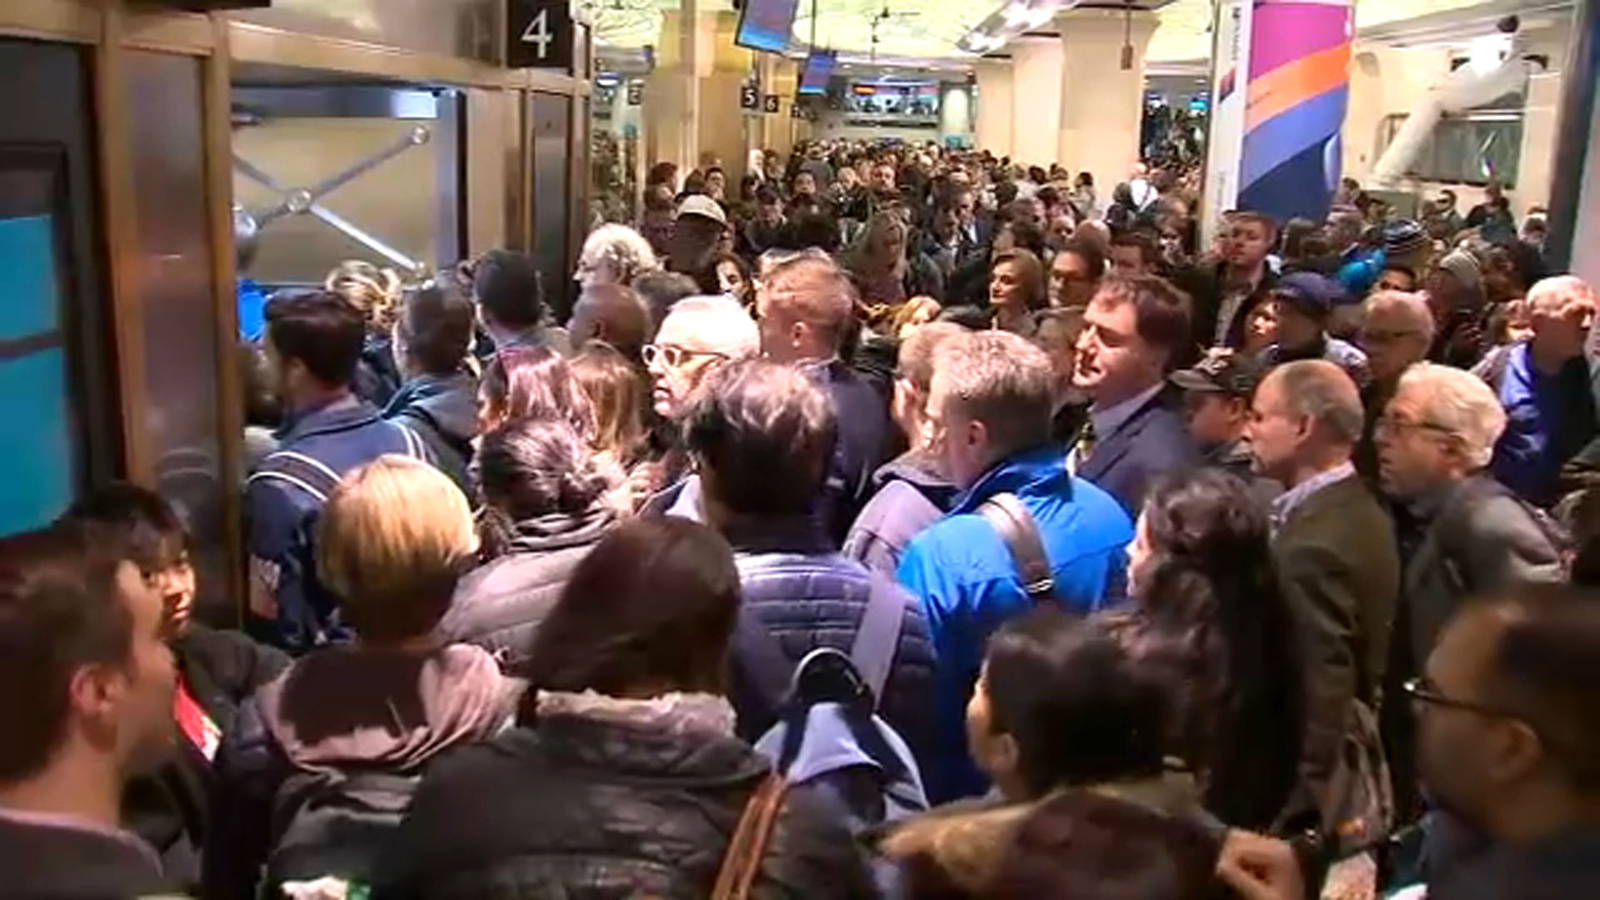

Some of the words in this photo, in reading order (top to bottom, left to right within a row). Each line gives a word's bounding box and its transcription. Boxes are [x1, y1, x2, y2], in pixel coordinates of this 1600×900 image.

[521, 8, 553, 59] 4
[744, 88, 756, 106] 5
[766, 97, 776, 111] 6
